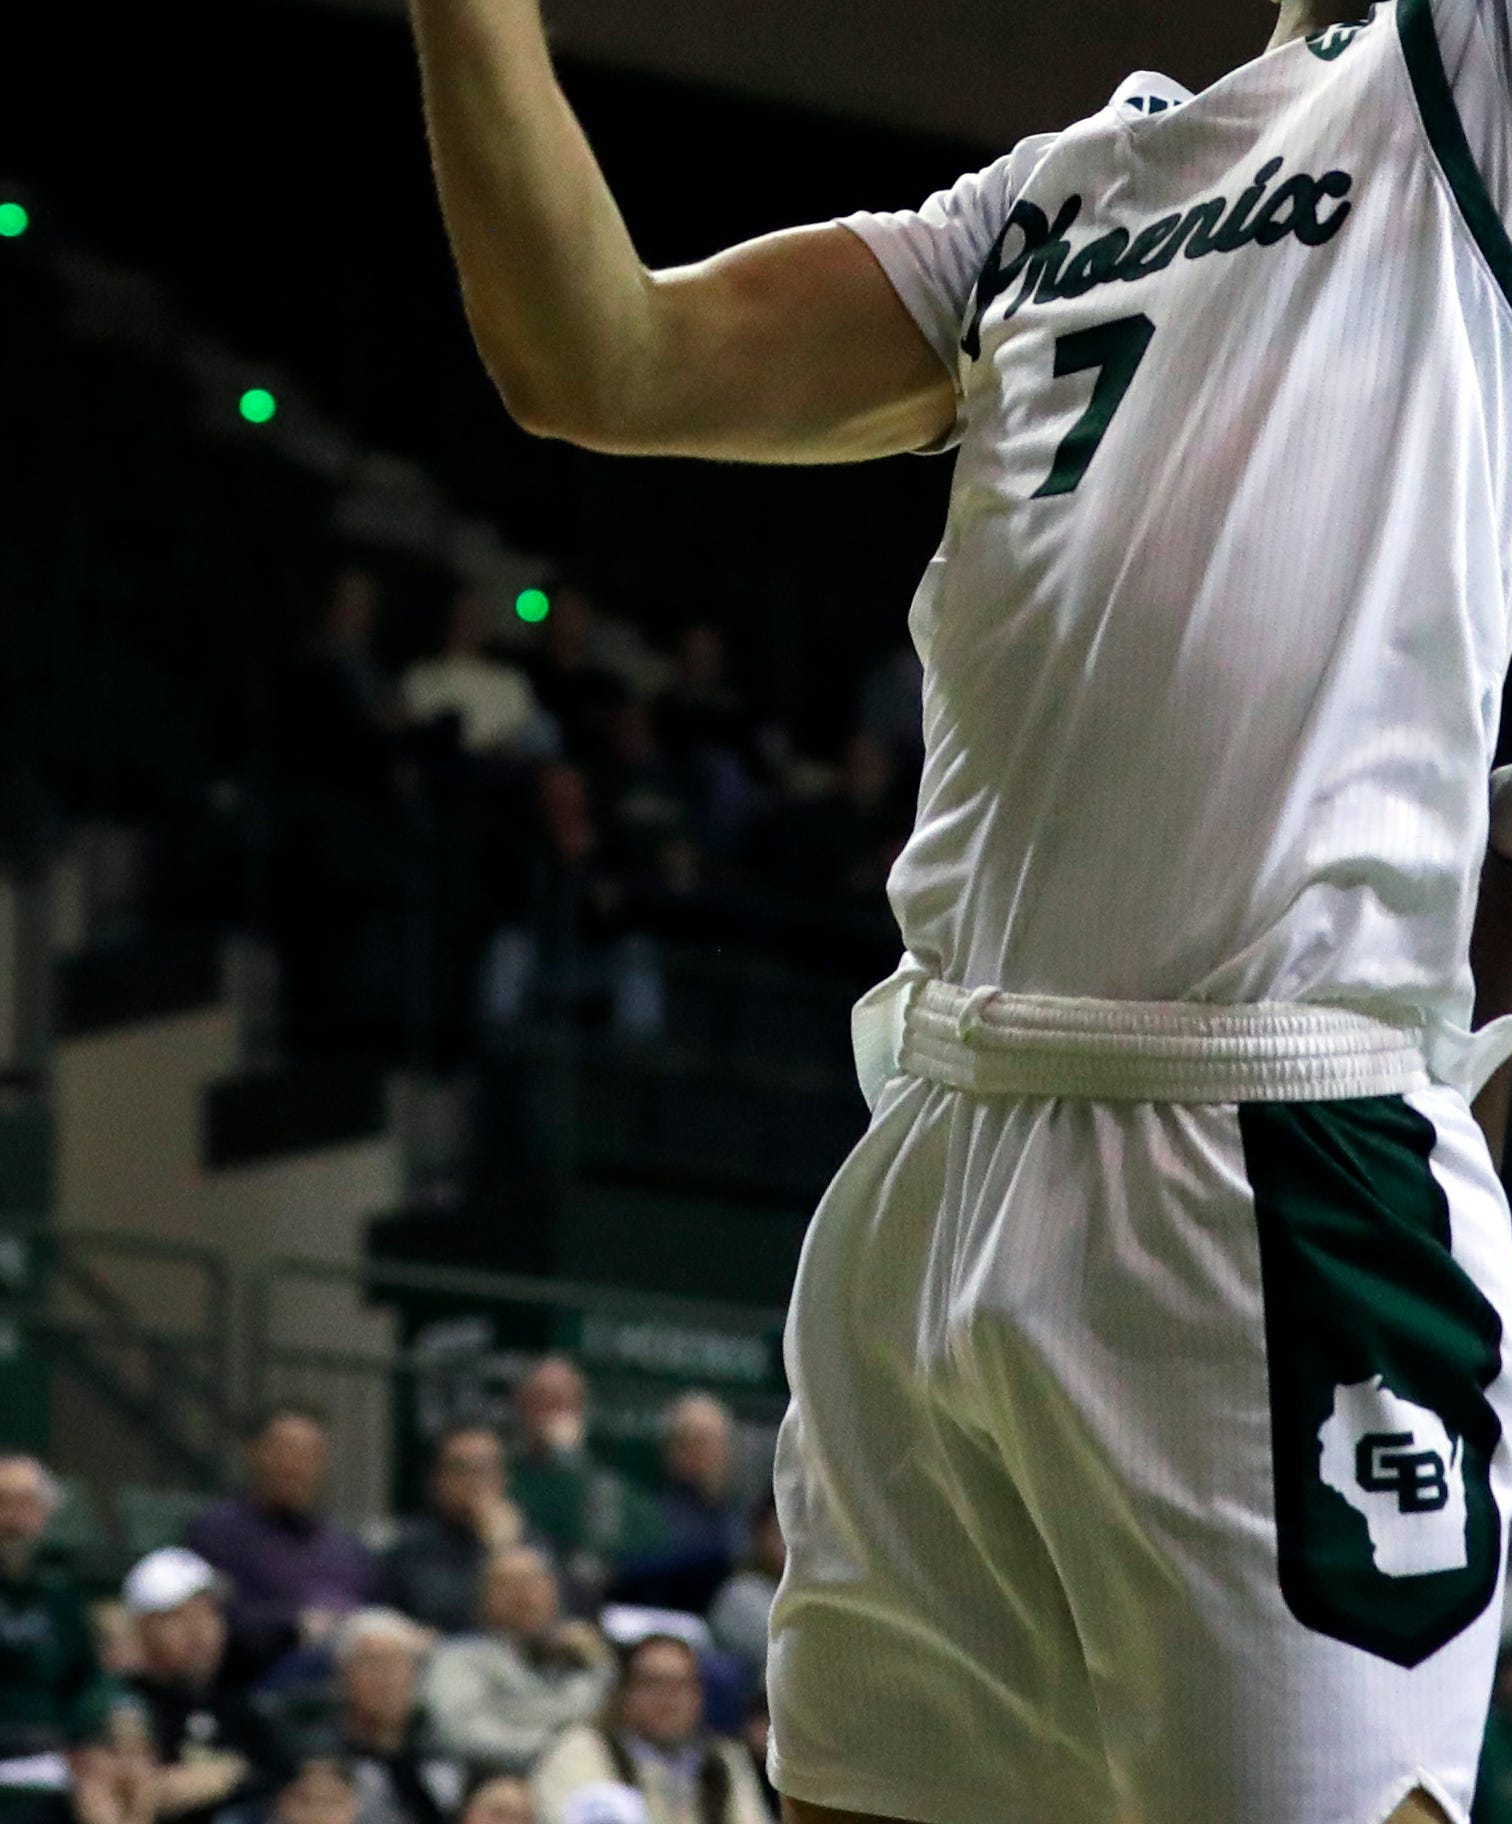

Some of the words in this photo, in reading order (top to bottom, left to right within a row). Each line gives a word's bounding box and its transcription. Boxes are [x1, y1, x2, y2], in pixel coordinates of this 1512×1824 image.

[960, 156, 1354, 362] Phoenix
[1030, 313, 1156, 499] 7
[1355, 1431, 1443, 1513] GB
